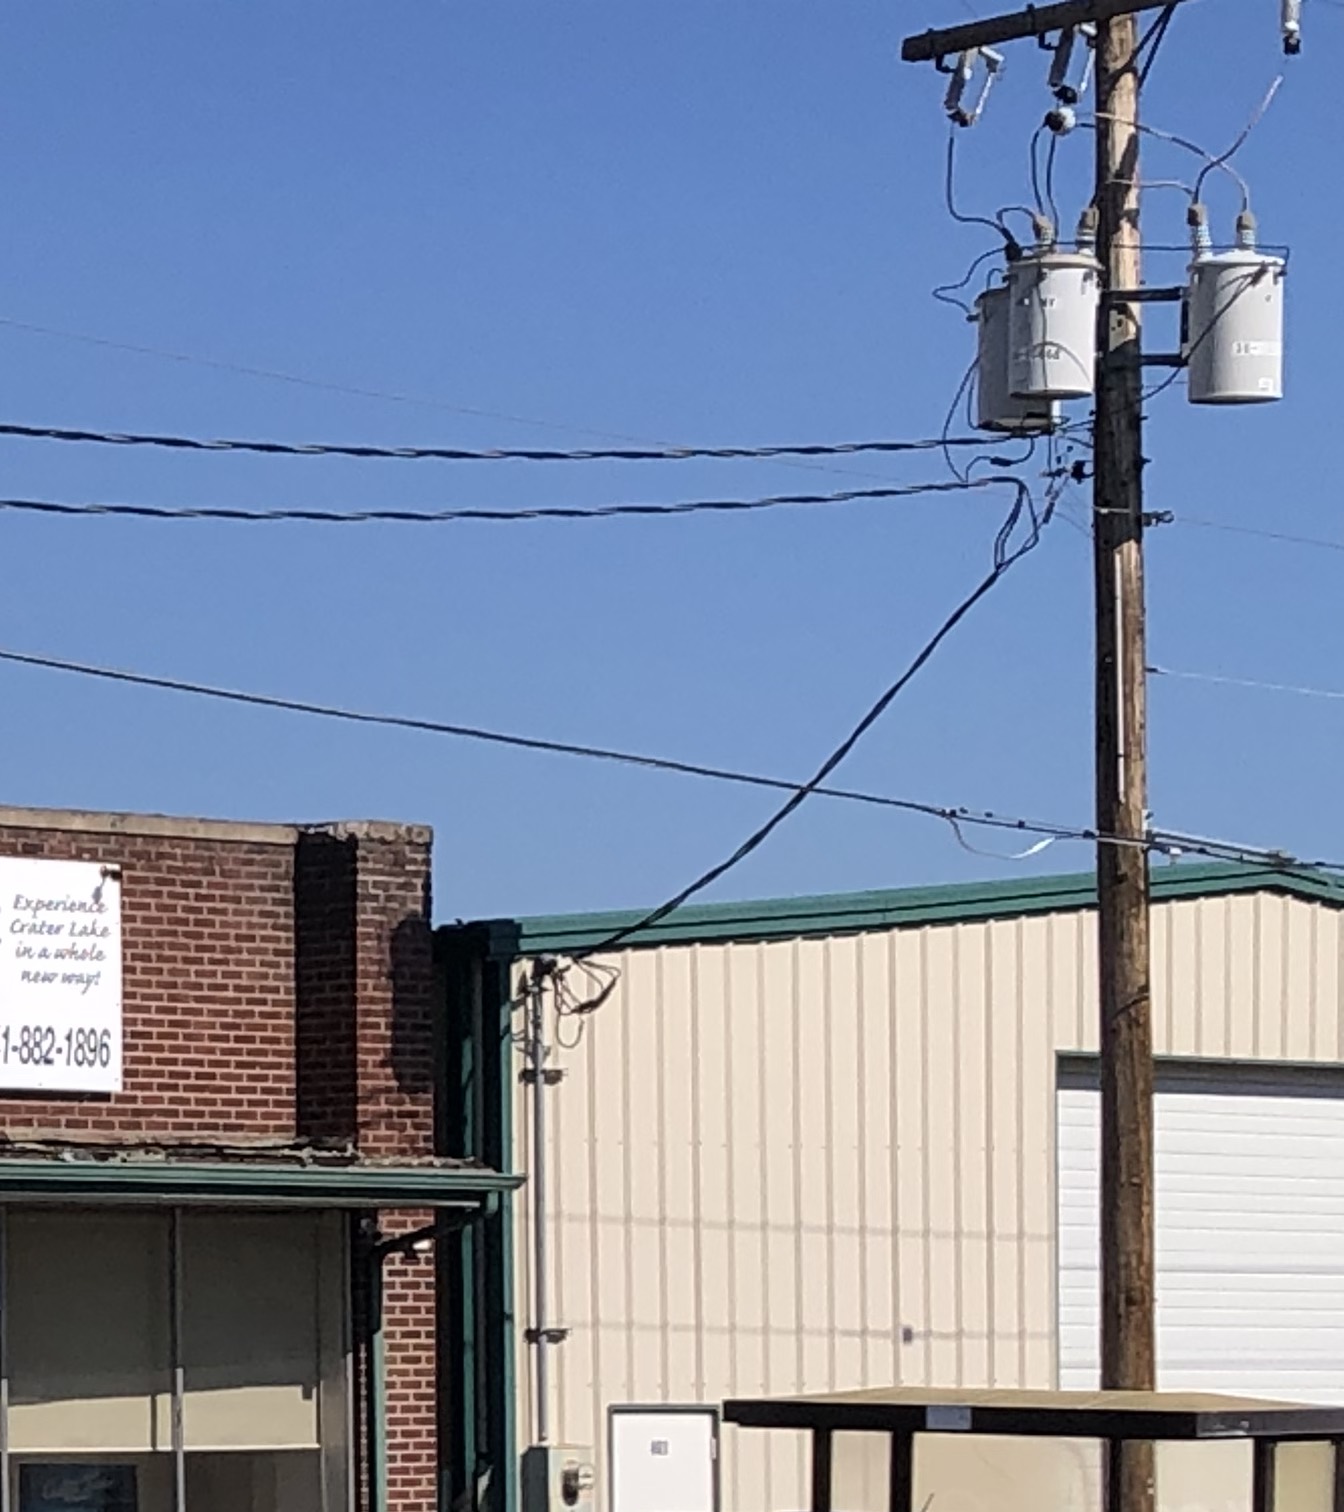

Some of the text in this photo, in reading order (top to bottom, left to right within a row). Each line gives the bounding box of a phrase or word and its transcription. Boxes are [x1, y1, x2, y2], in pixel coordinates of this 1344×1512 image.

[13, 893, 108, 919] Experience
[10, 918, 112, 938] Crater Lake
[15, 940, 107, 962] in a whole
[21, 969, 102, 995] new way!
